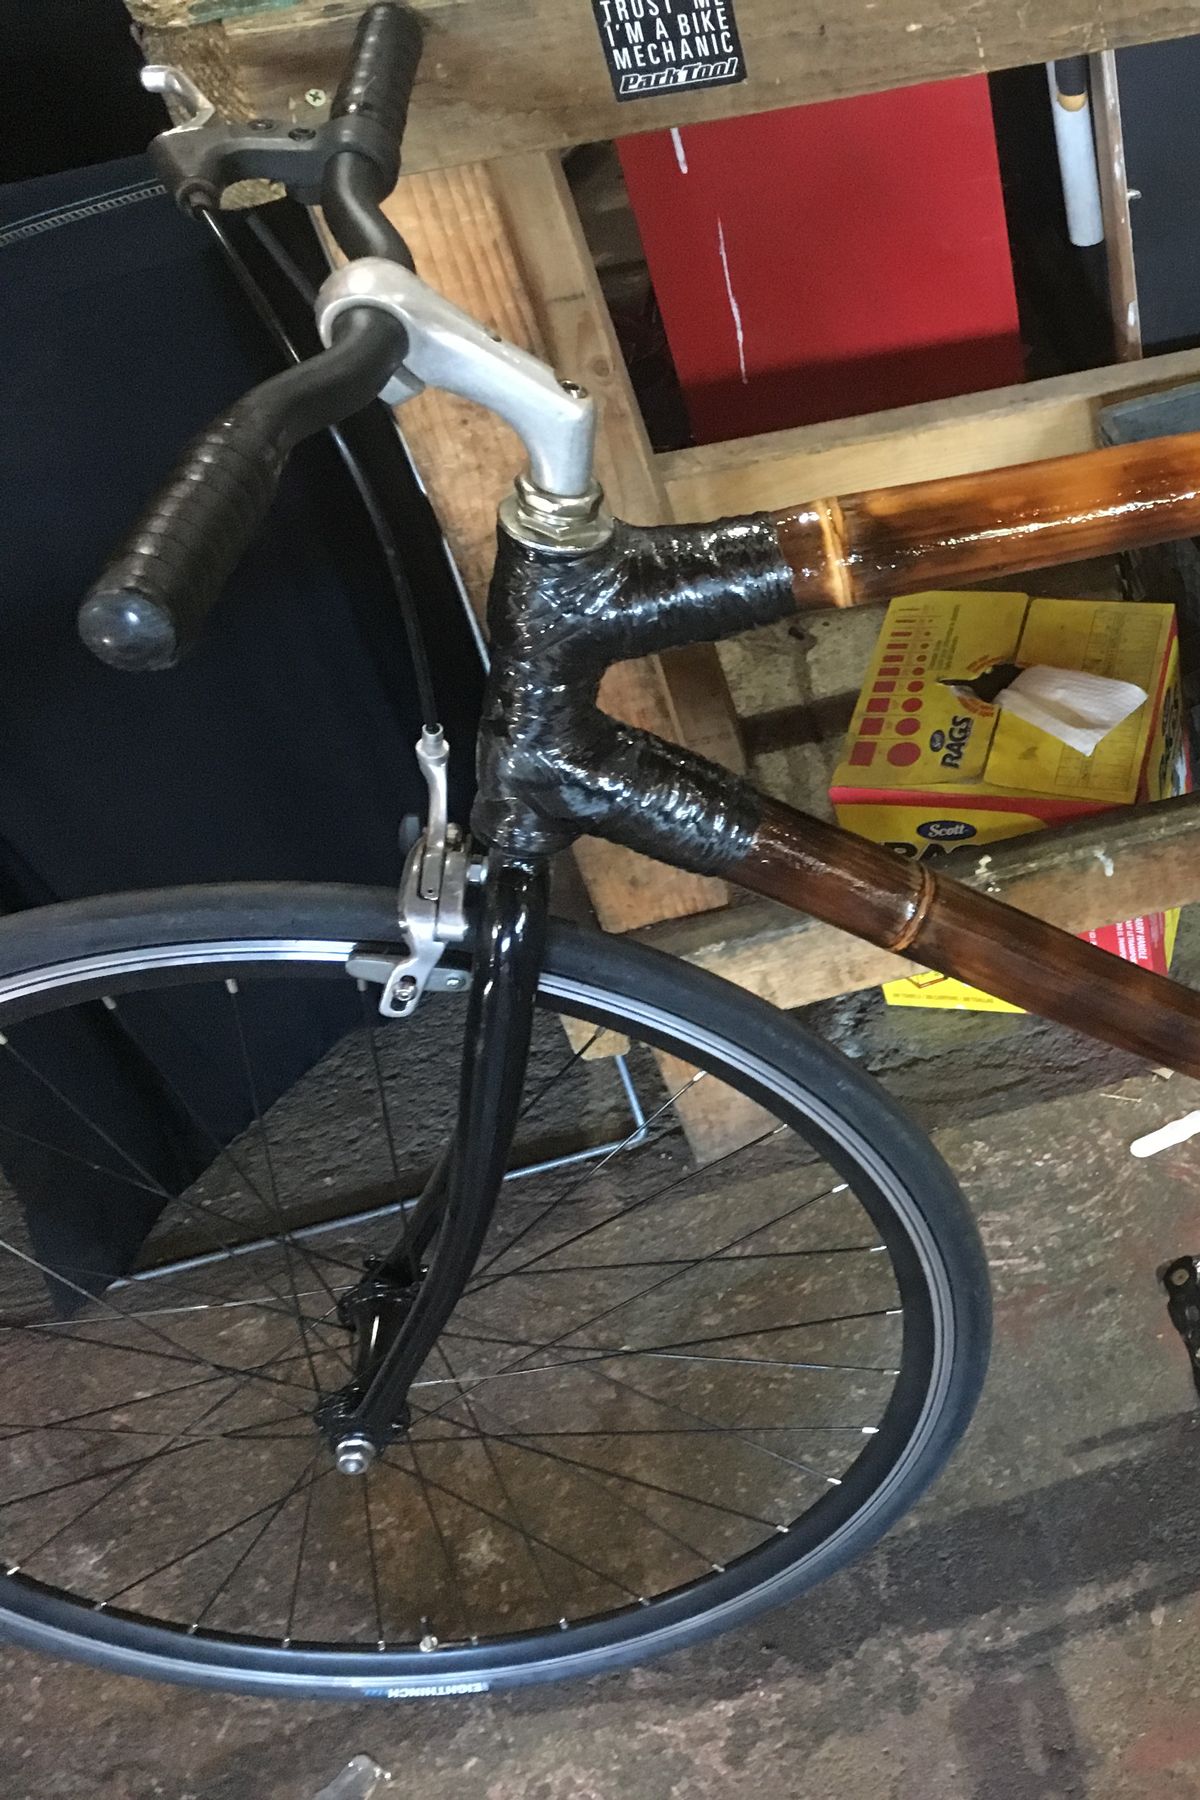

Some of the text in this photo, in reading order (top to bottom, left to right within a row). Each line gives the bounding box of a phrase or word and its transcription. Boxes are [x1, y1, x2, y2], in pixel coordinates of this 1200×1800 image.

[600, 0, 671, 22] TRUST
[606, 8, 729, 47] I'M A BIKE
[612, 31, 734, 70] MECHANIC
[940, 715, 973, 769] RAGS
[928, 824, 965, 837] Scott
